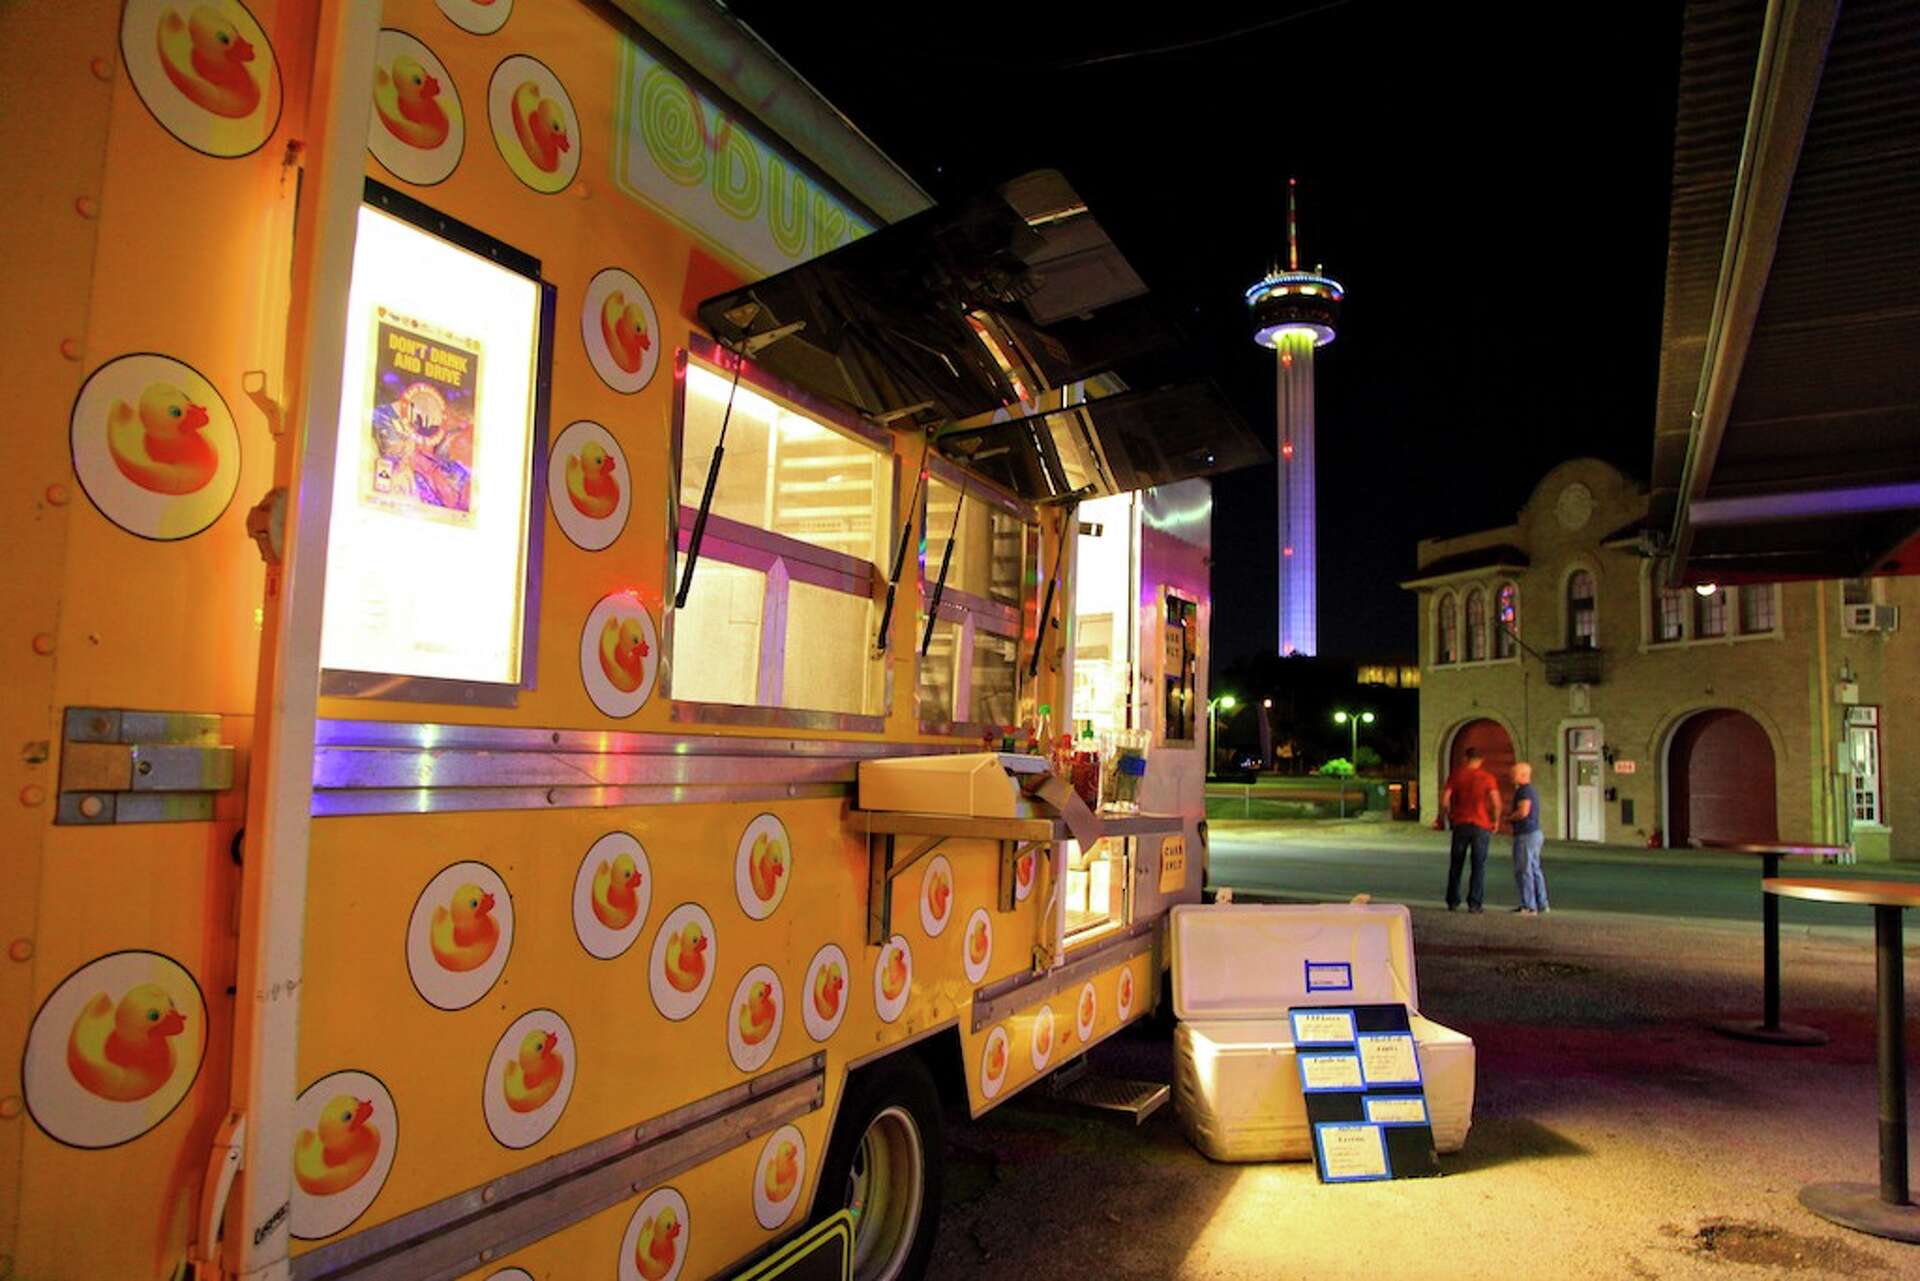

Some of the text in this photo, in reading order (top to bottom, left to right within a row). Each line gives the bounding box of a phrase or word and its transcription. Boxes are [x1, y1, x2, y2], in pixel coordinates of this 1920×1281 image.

[389, 333, 428, 359] DON'T
[431, 346, 468, 374] DRINK
[394, 352, 462, 386] AND DRIVE
